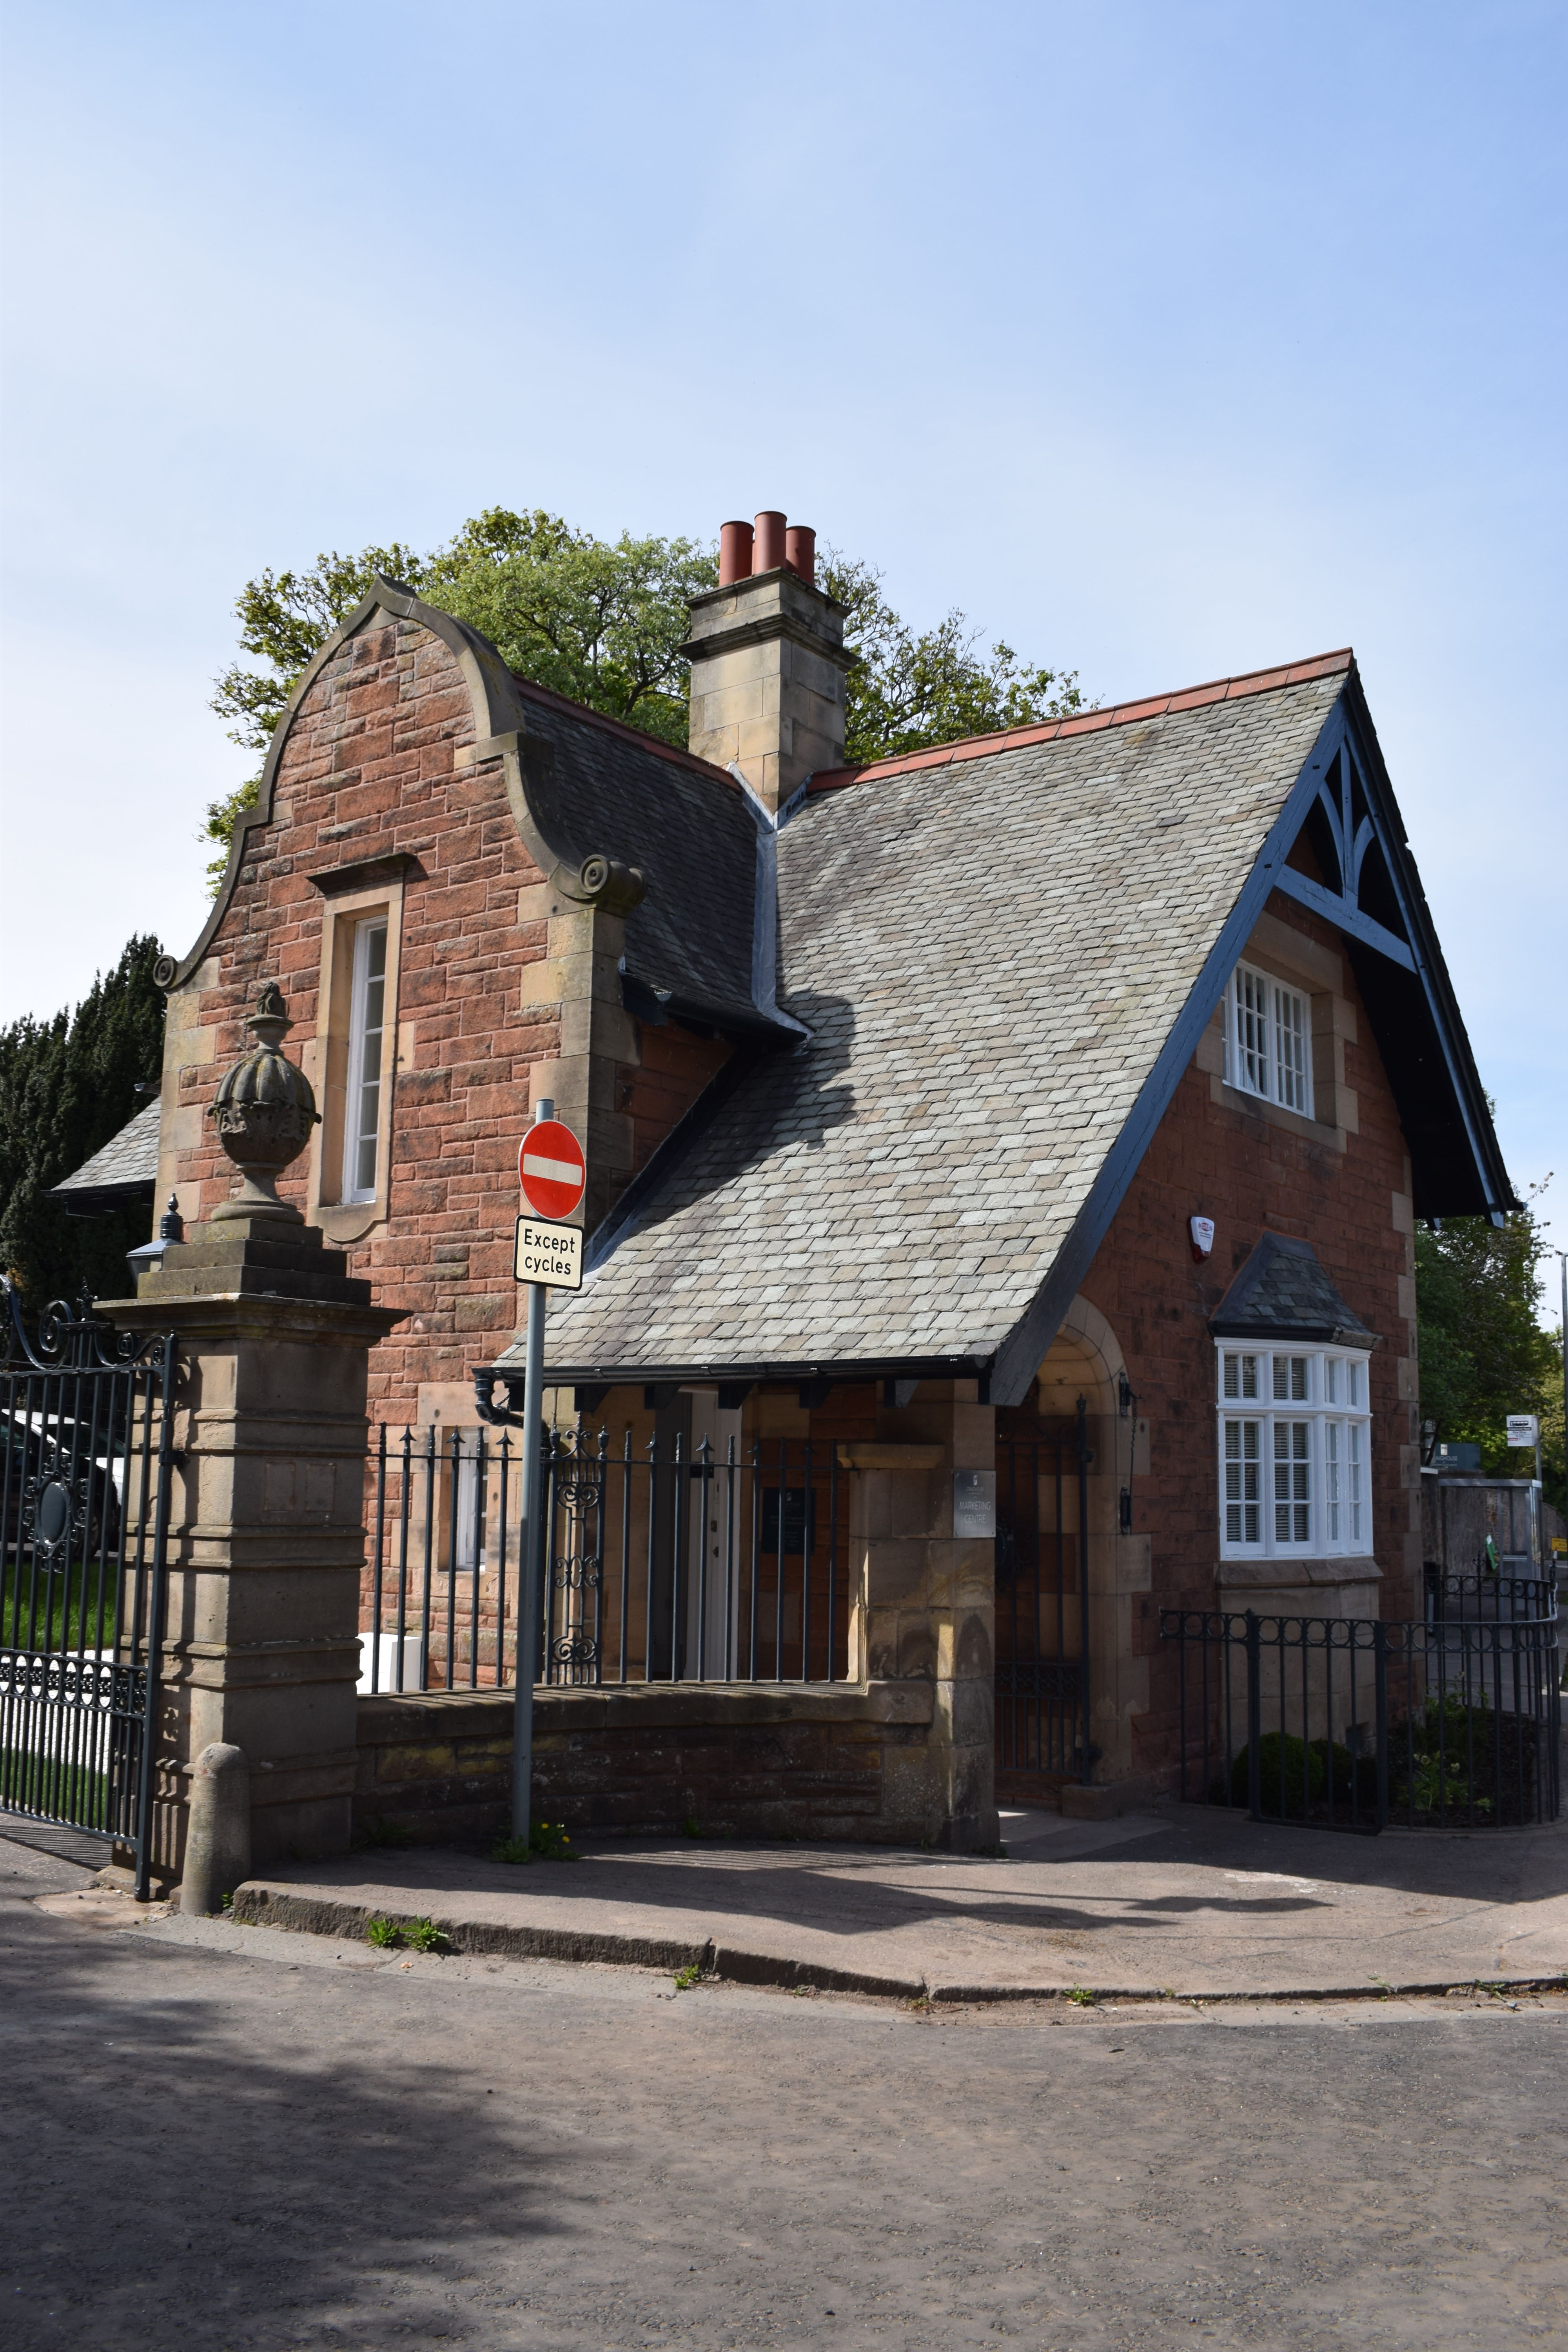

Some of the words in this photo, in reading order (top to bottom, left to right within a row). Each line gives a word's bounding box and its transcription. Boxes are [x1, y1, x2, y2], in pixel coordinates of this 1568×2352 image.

[524, 1228, 575, 1254] Except
[525, 1256, 571, 1275] cycles
[959, 1501, 991, 1510] MARKETING
[964, 1514, 985, 1523] CENTRE
